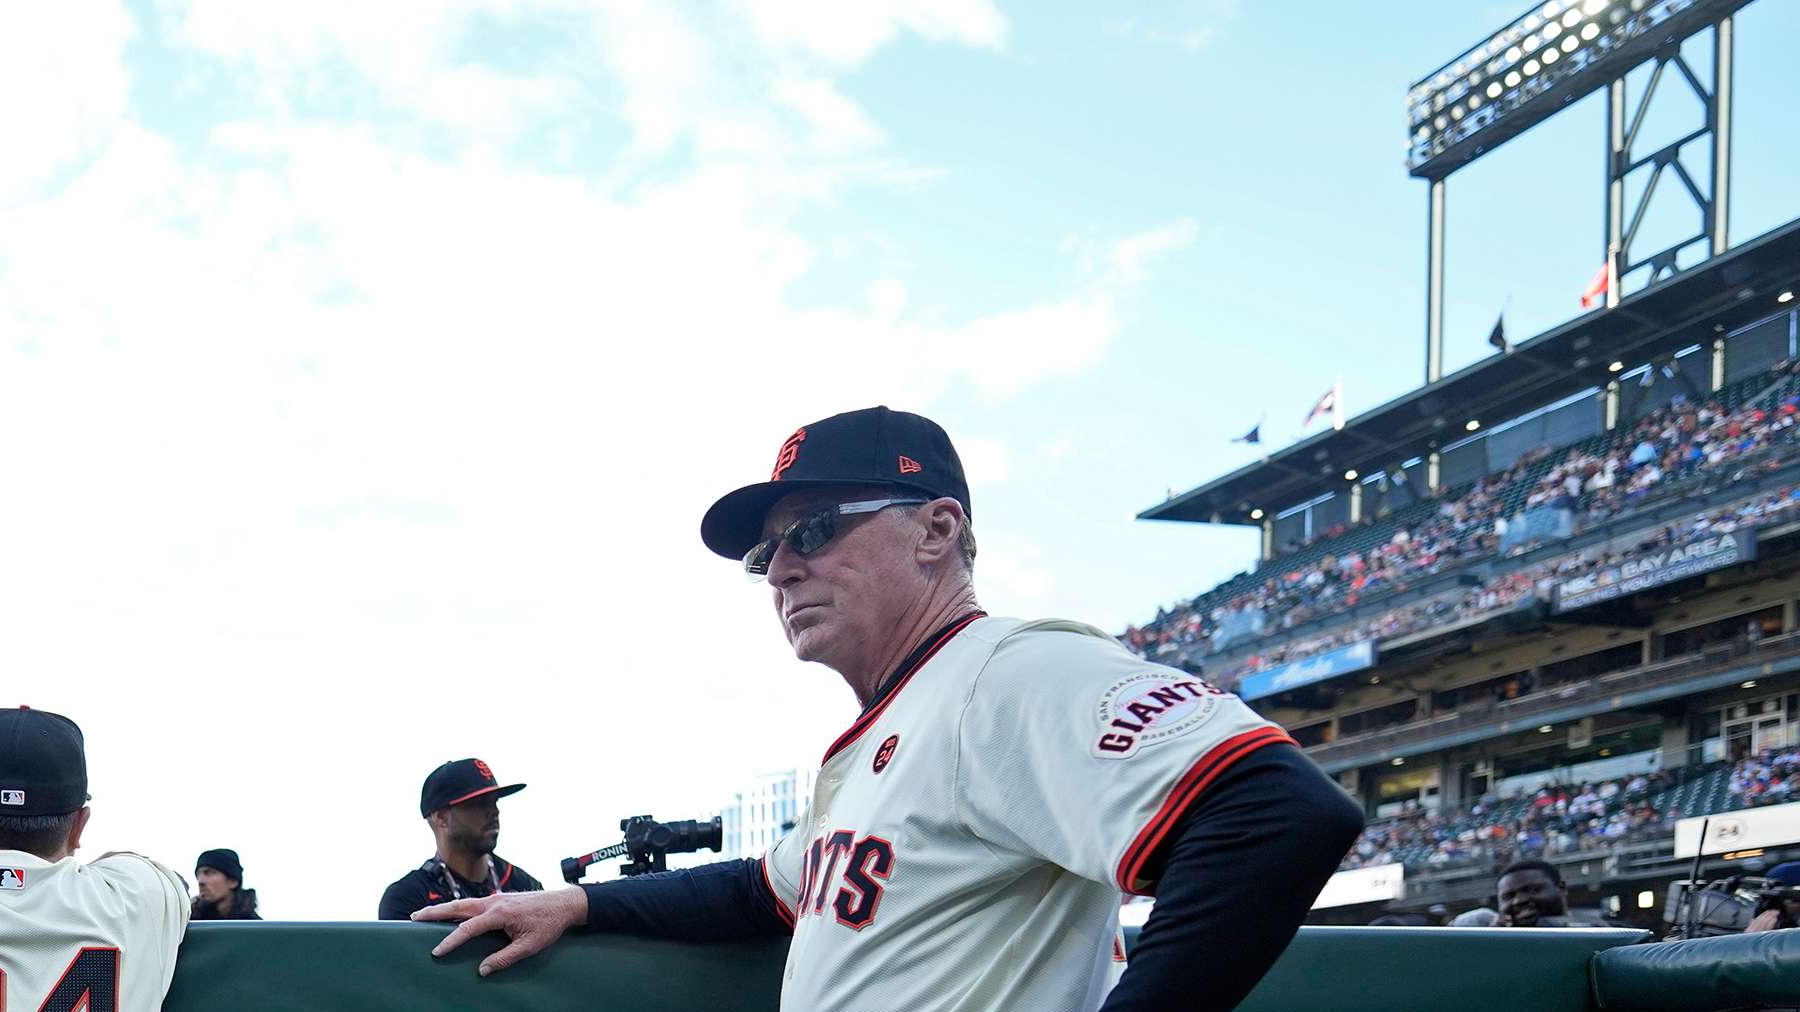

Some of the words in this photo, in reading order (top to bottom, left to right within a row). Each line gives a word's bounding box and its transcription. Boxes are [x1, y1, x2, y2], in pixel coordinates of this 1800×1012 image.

[1621, 552, 1667, 579] BAY
[1668, 533, 1737, 565] AREA
[875, 747, 894, 767] 24
[591, 843, 628, 862] RONIN
